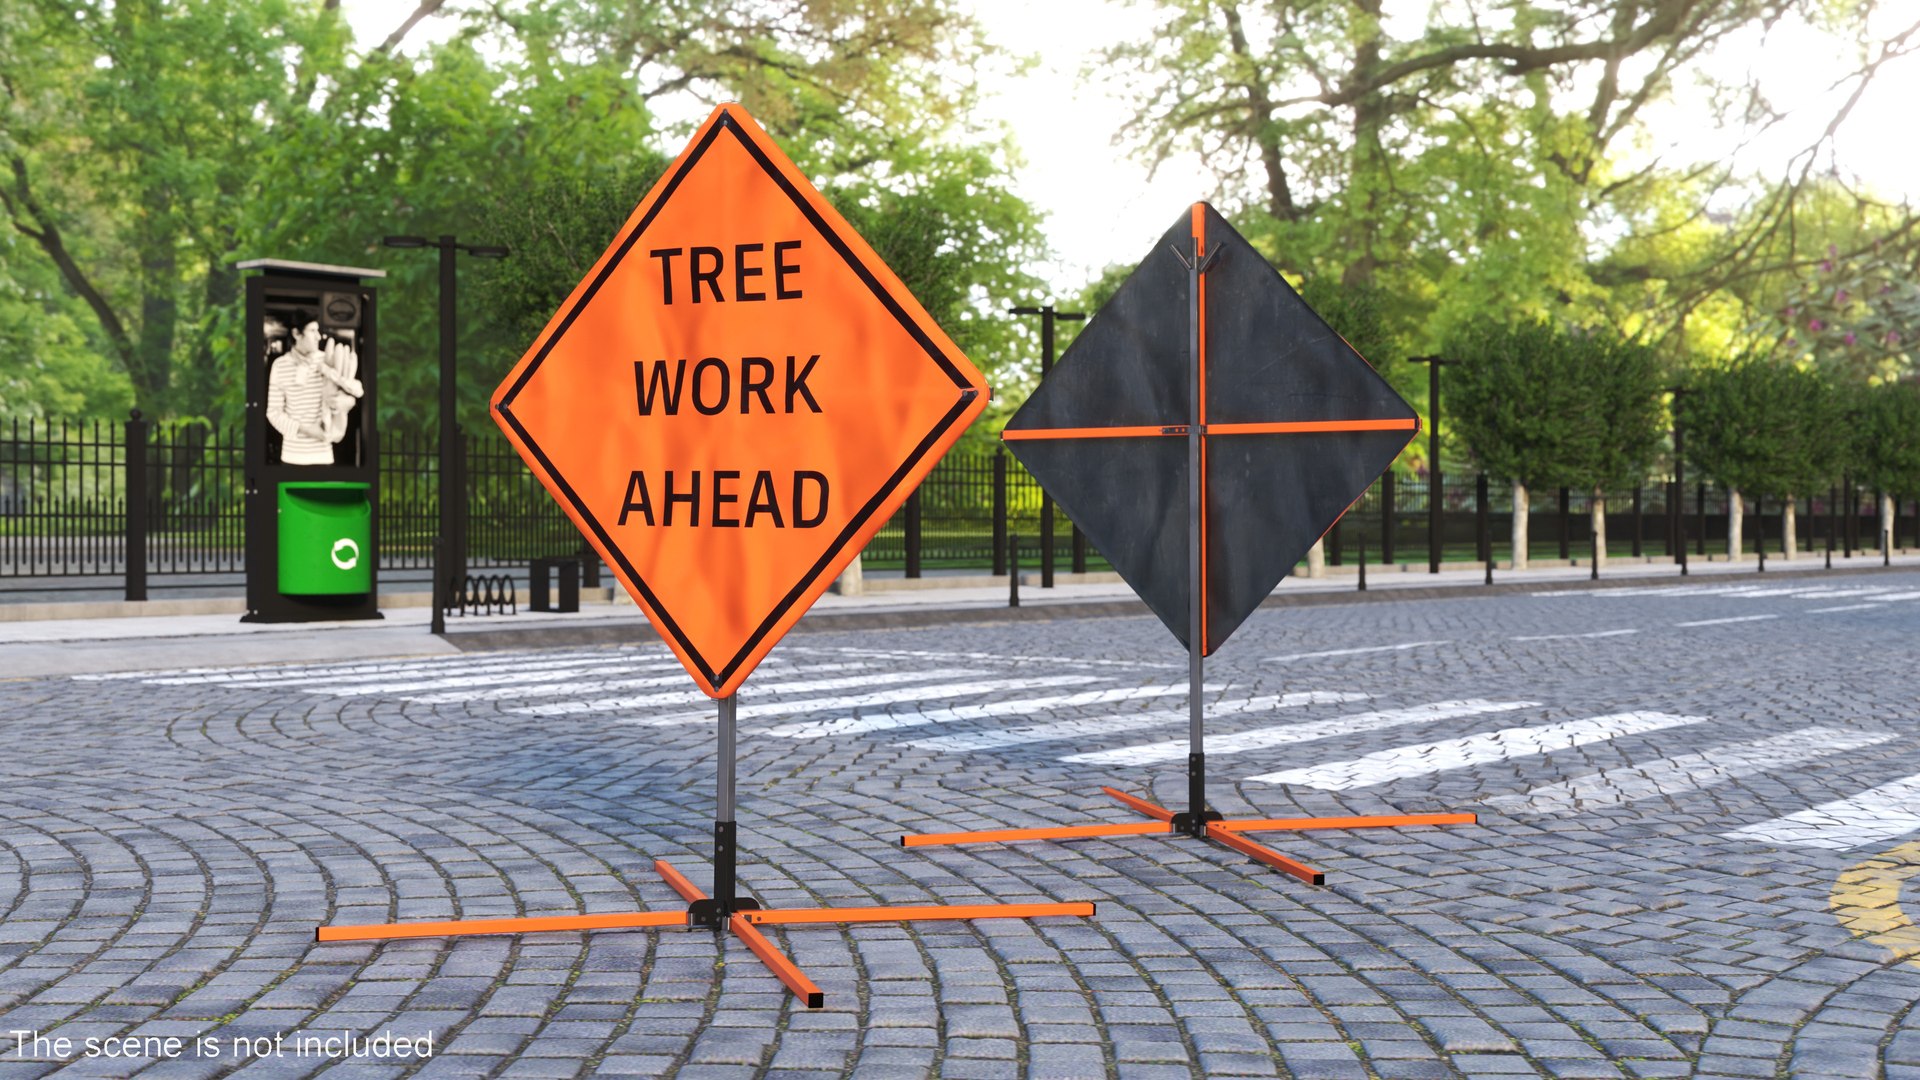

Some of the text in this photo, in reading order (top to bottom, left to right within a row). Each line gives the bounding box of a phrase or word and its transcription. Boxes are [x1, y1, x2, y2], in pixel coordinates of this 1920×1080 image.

[650, 240, 803, 305] TREE
[634, 354, 823, 416] WORK
[617, 470, 830, 529] AHEAD
